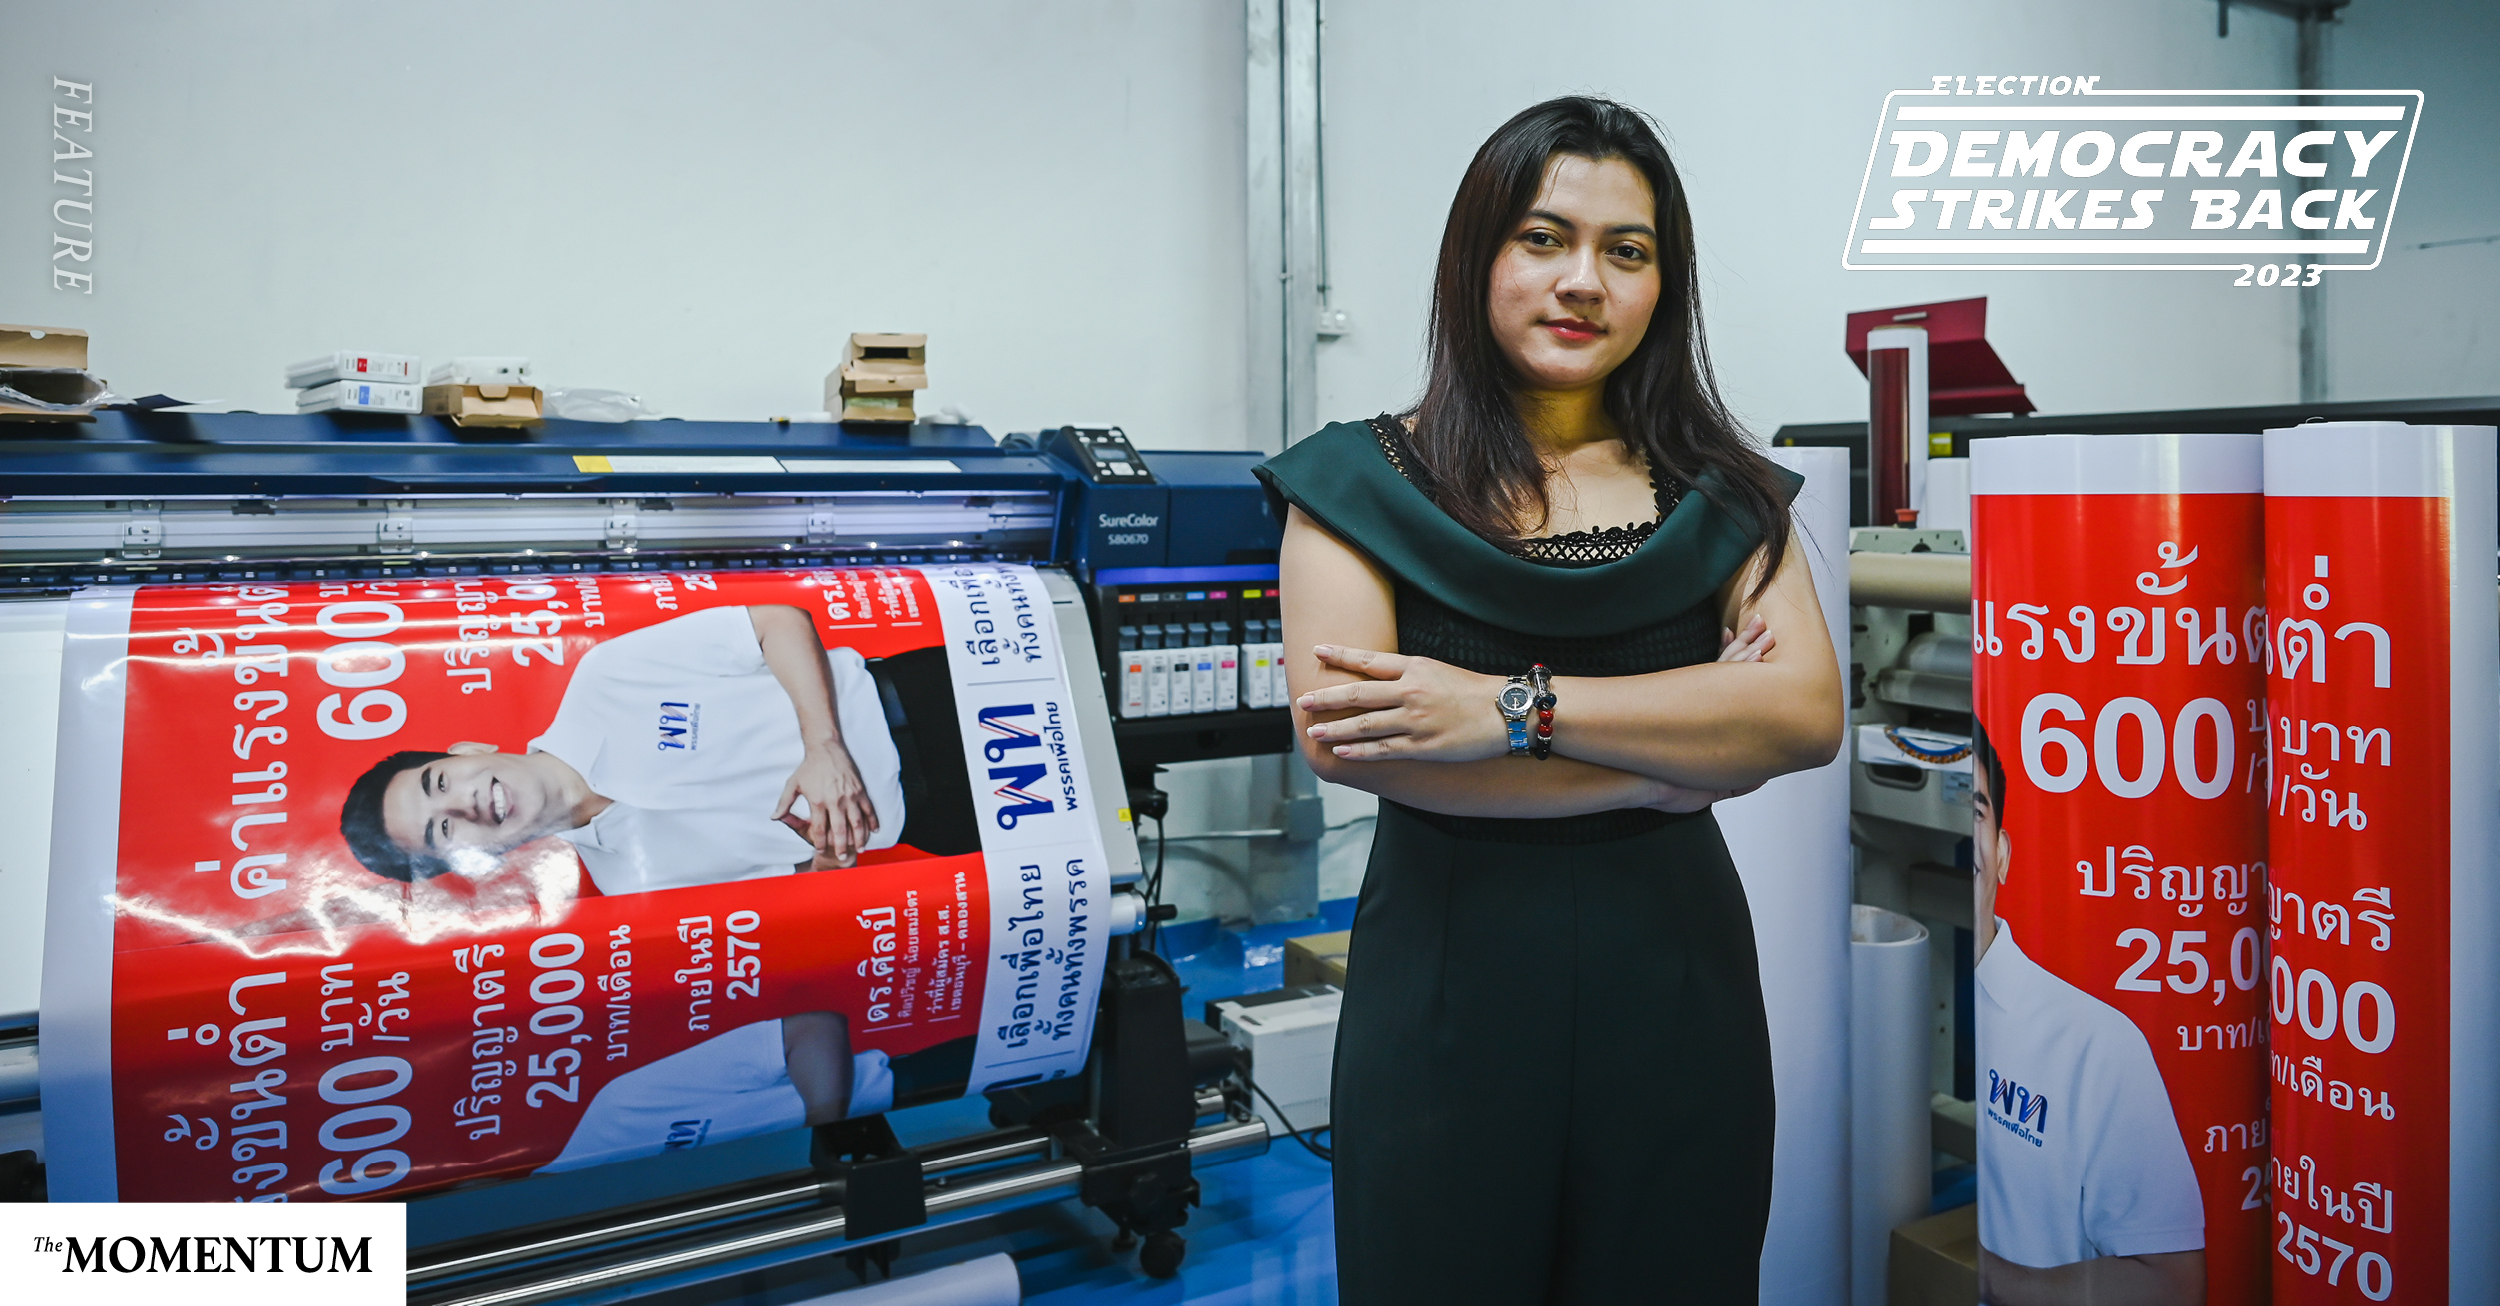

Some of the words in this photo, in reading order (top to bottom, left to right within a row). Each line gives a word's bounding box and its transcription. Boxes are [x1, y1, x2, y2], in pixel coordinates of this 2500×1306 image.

[1099, 513, 1159, 528] SureColor
[316, 601, 408, 740] 600
[444, 580, 501, 694] ปริญญา
[941, 568, 1000, 666] เลือกเพื่อ
[2266, 555, 2391, 689] ต่ำ
[1043, 701, 1078, 811] พรรคเพื่อไทย
[2019, 692, 2235, 800] 600
[2280, 716, 2391, 767] บาท
[2280, 762, 2368, 831] /วัน
[2077, 845, 2267, 918] ปริญญา
[597, 924, 632, 1061] บาท/เดือน
[674, 915, 713, 1031] ภายในปี
[726, 910, 761, 1000] 2570
[856, 906, 897, 1022] ดร.ศิลป์
[997, 864, 1044, 1048] เลือกเพื่อไทย
[1034, 859, 1087, 1041] ทั้งคนทั้งพรรค
[320, 963, 354, 1051] บาท
[358, 971, 410, 1041] /วัน
[453, 943, 518, 1140] ปริญญาตรี
[526, 933, 592, 1108] 25,000
[318, 1056, 413, 1195] 600
[1988, 1107, 2043, 1148] พรรคเพื่อไทย
[2277, 1212, 2393, 1301] 2570
